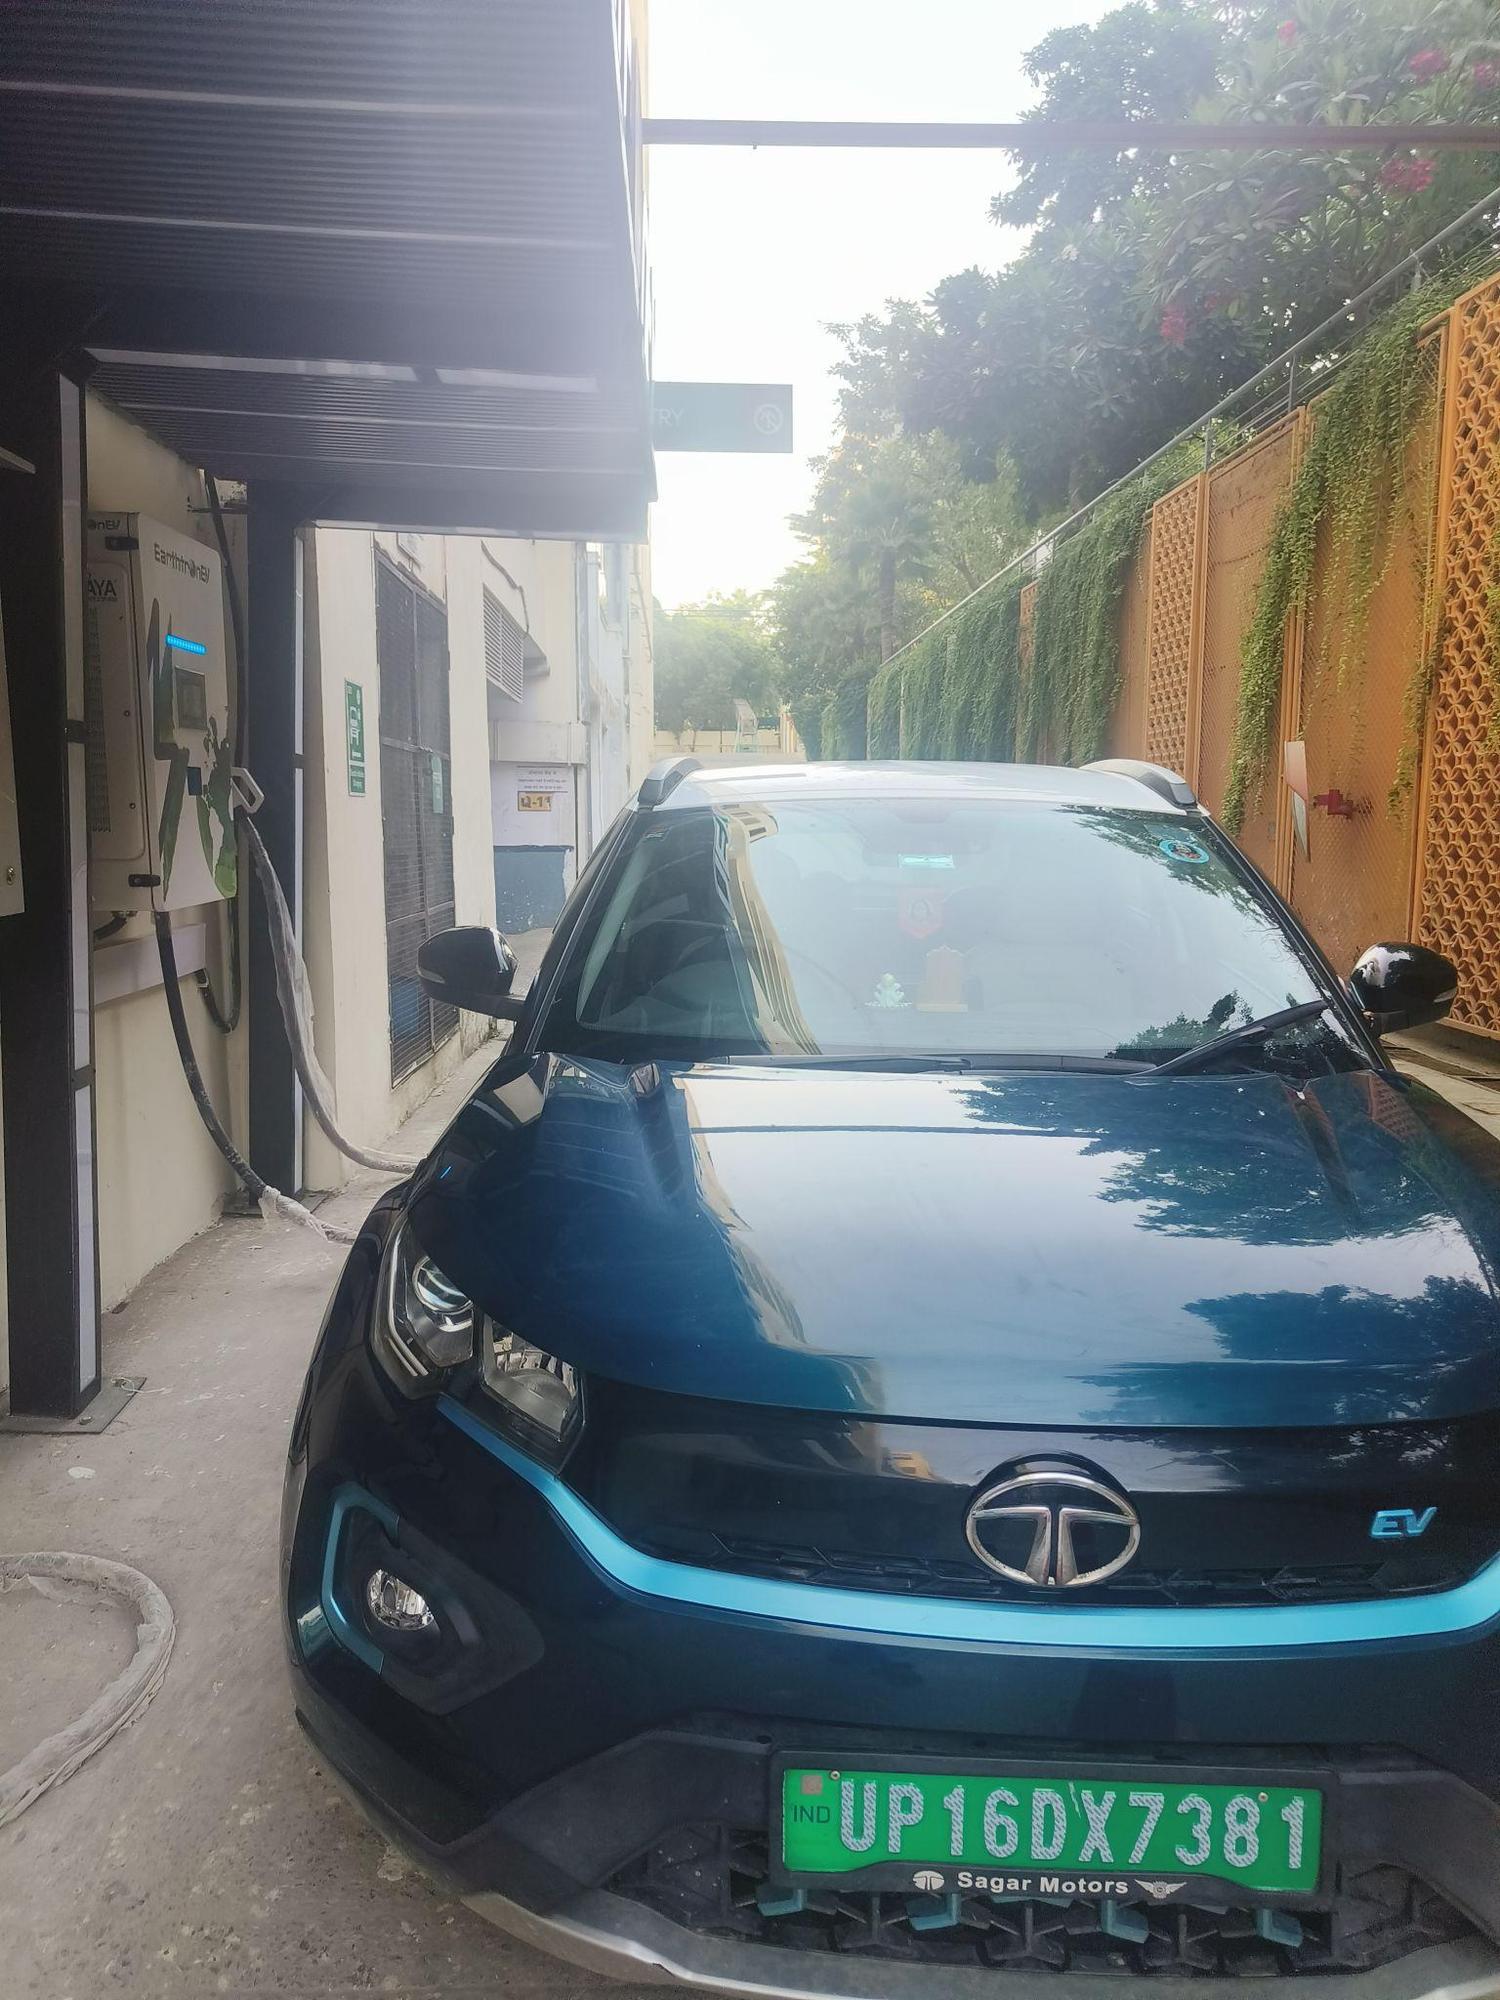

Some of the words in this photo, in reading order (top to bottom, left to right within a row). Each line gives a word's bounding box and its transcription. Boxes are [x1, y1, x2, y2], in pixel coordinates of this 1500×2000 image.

[1371, 1506, 1438, 1539] EV
[792, 1805, 832, 1824] IND
[957, 1871, 1031, 1894] Sagar
[1039, 1875, 1129, 1896] Motors
